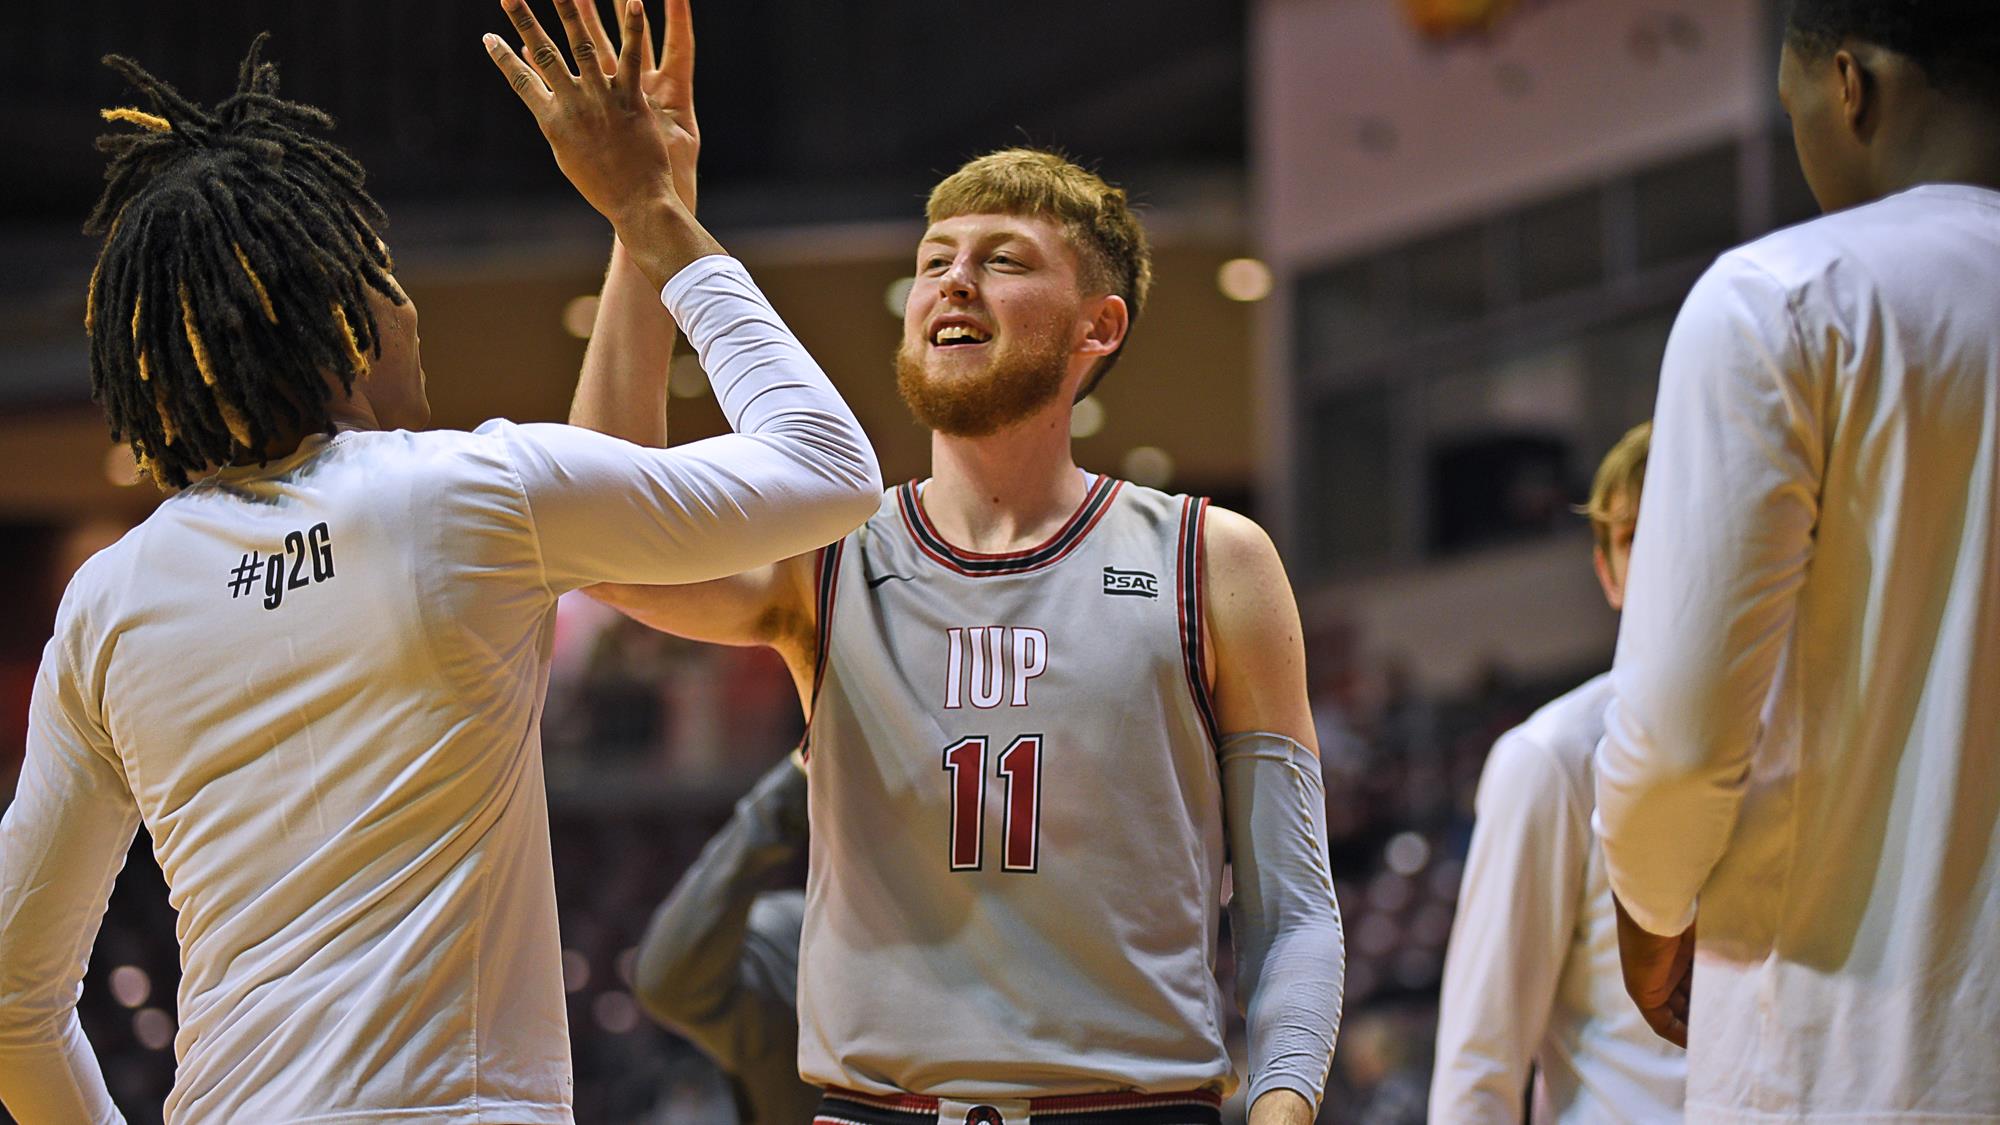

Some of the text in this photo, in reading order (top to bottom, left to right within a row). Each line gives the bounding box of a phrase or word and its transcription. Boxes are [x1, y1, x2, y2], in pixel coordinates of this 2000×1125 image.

[227, 521, 335, 611] #g2G
[1103, 573, 1159, 593] PSAC
[944, 626, 1048, 709] IUP
[943, 734, 1043, 874] 11
